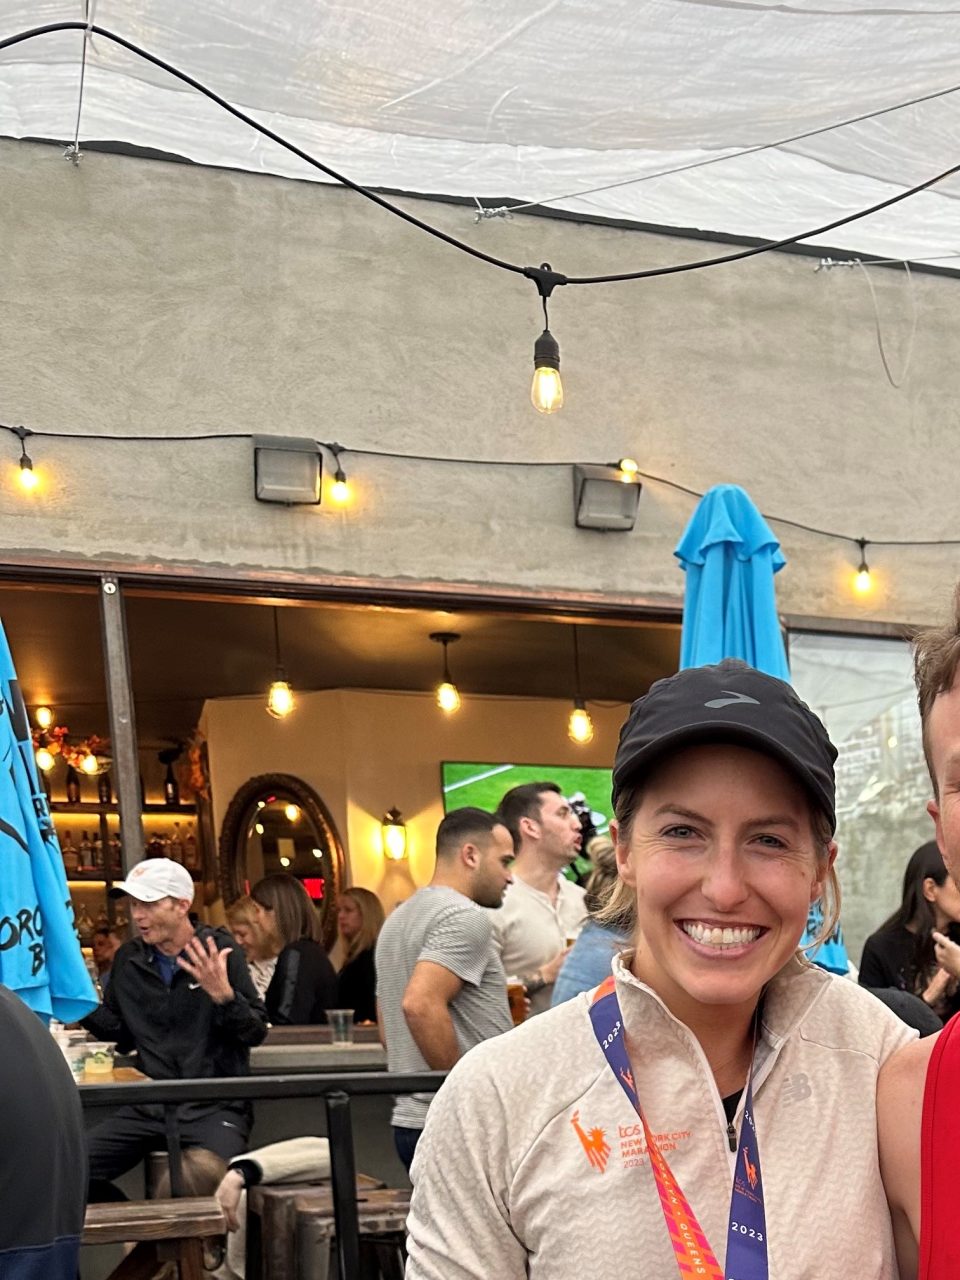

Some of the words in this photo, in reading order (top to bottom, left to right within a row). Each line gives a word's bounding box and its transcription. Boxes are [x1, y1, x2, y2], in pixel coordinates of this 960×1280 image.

[603, 1021, 621, 1049] 2023
[620, 1139, 642, 1149] NEW
[624, 1158, 645, 1168] 2023
[731, 1222, 764, 1241] 2023
[680, 1223, 706, 1274] QUEENS
